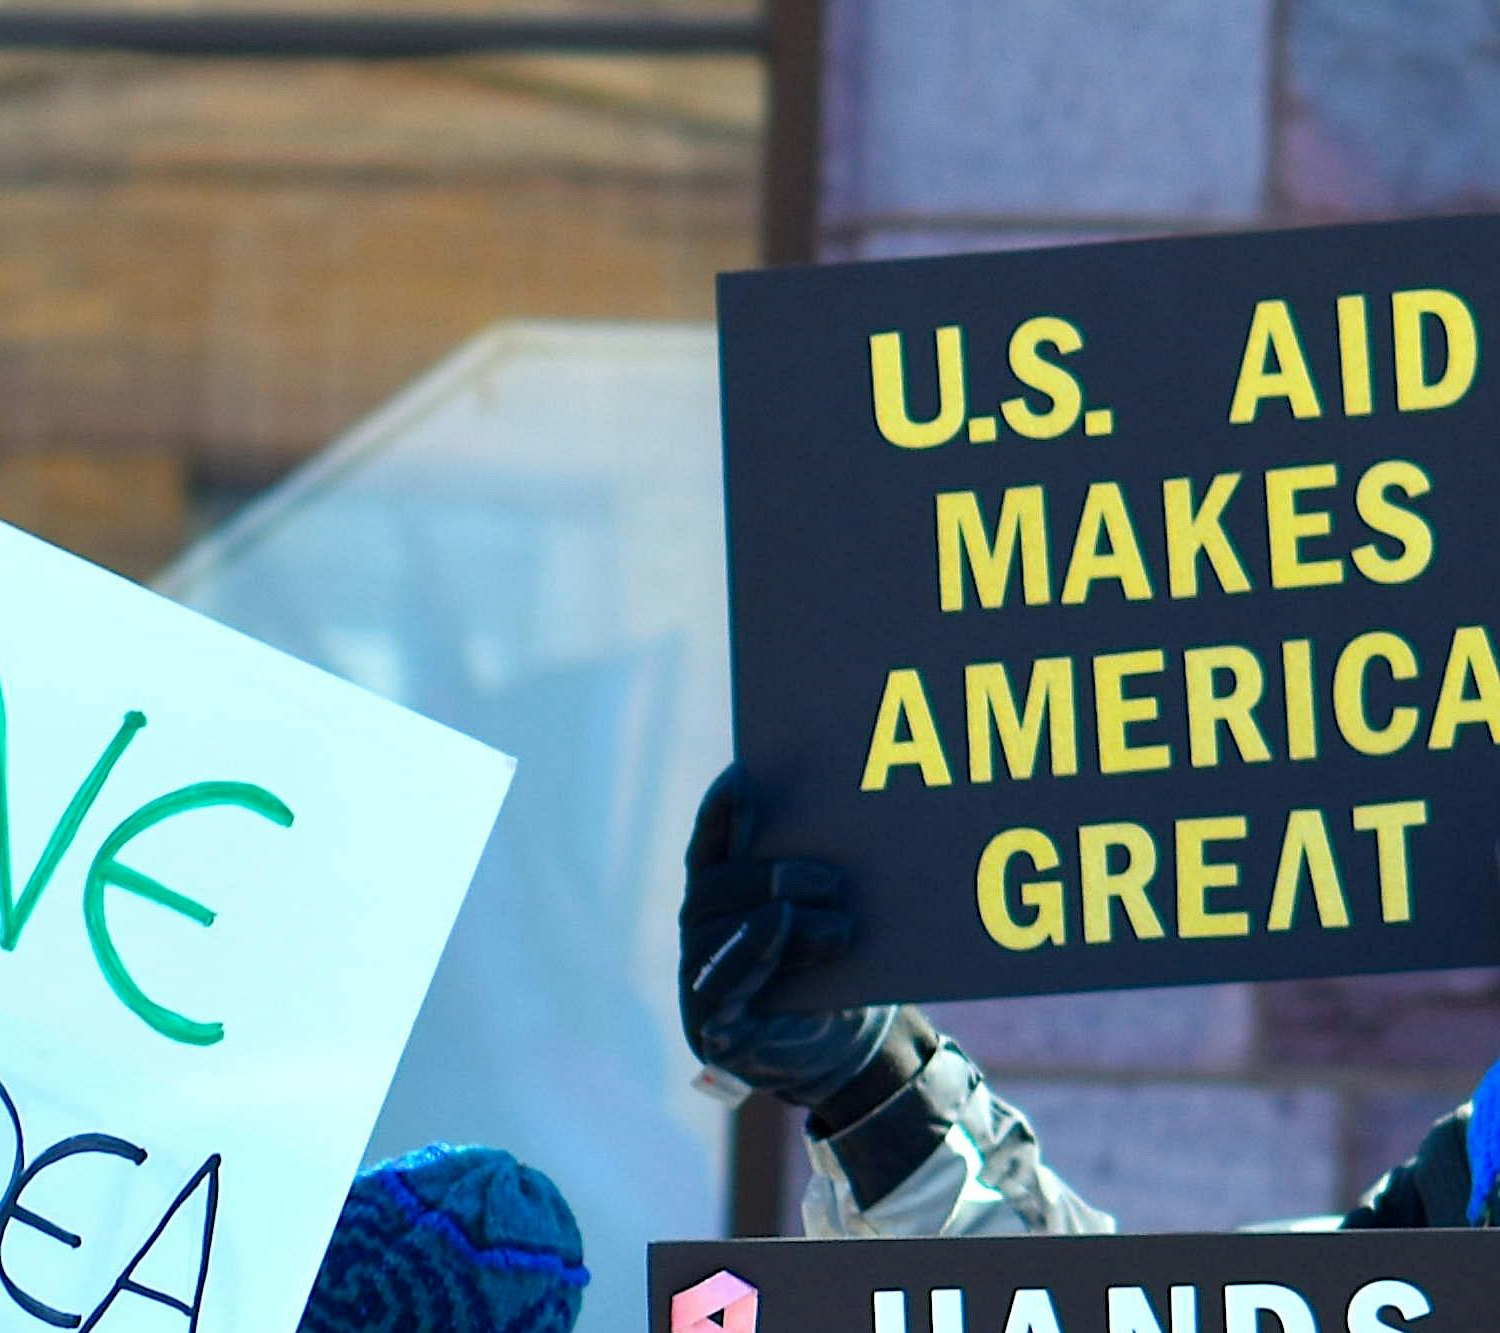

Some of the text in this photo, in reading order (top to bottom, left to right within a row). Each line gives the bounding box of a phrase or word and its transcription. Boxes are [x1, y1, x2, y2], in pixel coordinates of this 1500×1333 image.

[869, 288, 1480, 449] U.S. AID
[935, 459, 1434, 613] MAKES
[860, 625, 1500, 791] AMERICA
[975, 800, 1428, 952] GREAT
